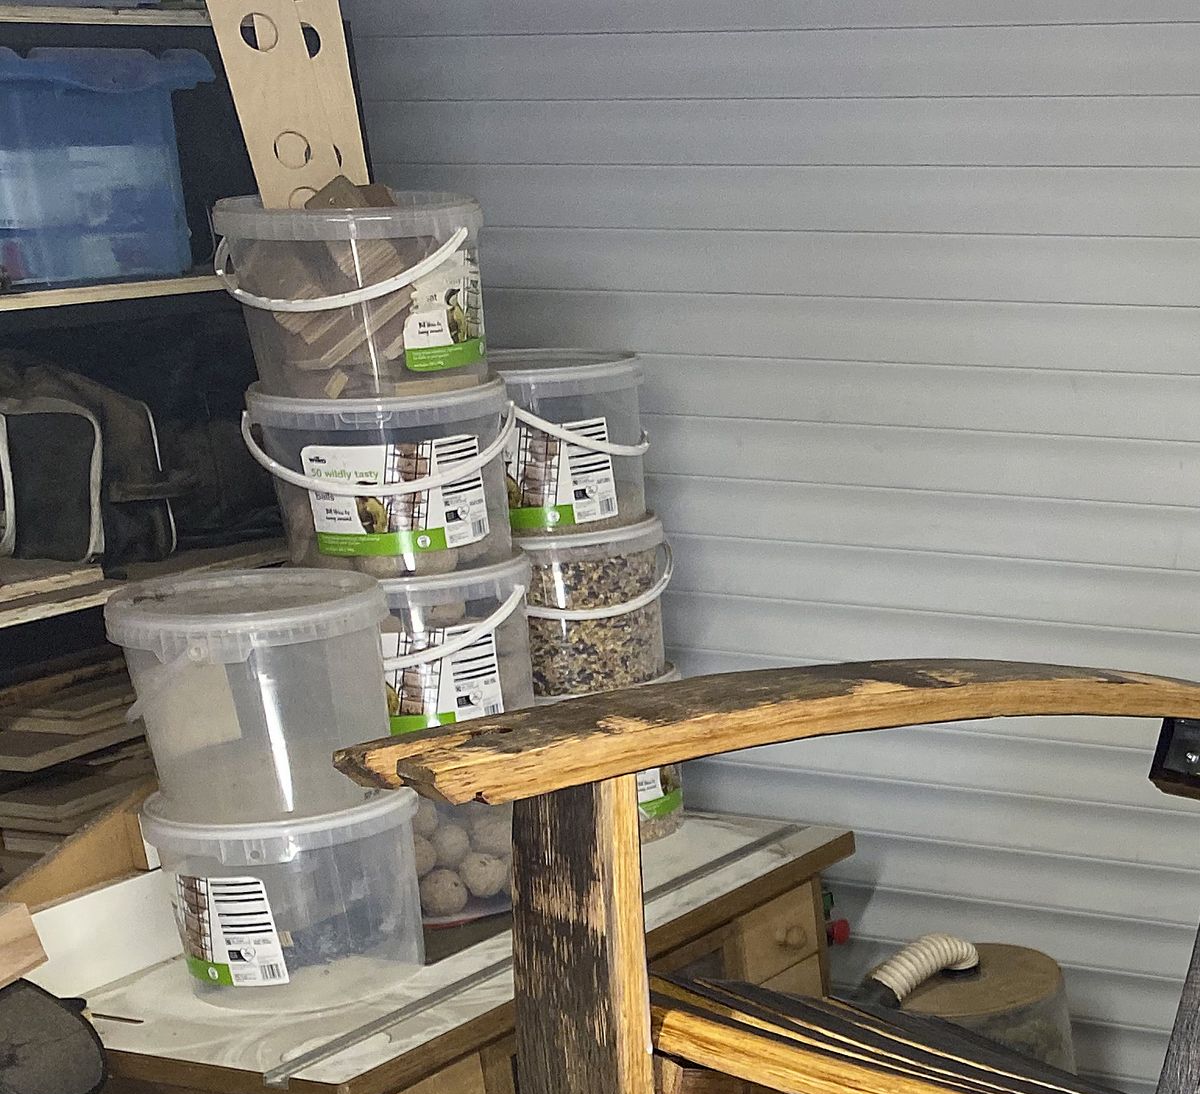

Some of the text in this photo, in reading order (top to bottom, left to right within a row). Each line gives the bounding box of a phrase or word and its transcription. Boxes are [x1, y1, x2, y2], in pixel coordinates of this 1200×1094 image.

[309, 456, 326, 464] wilko
[311, 467, 379, 481] 50 wildly tasty
